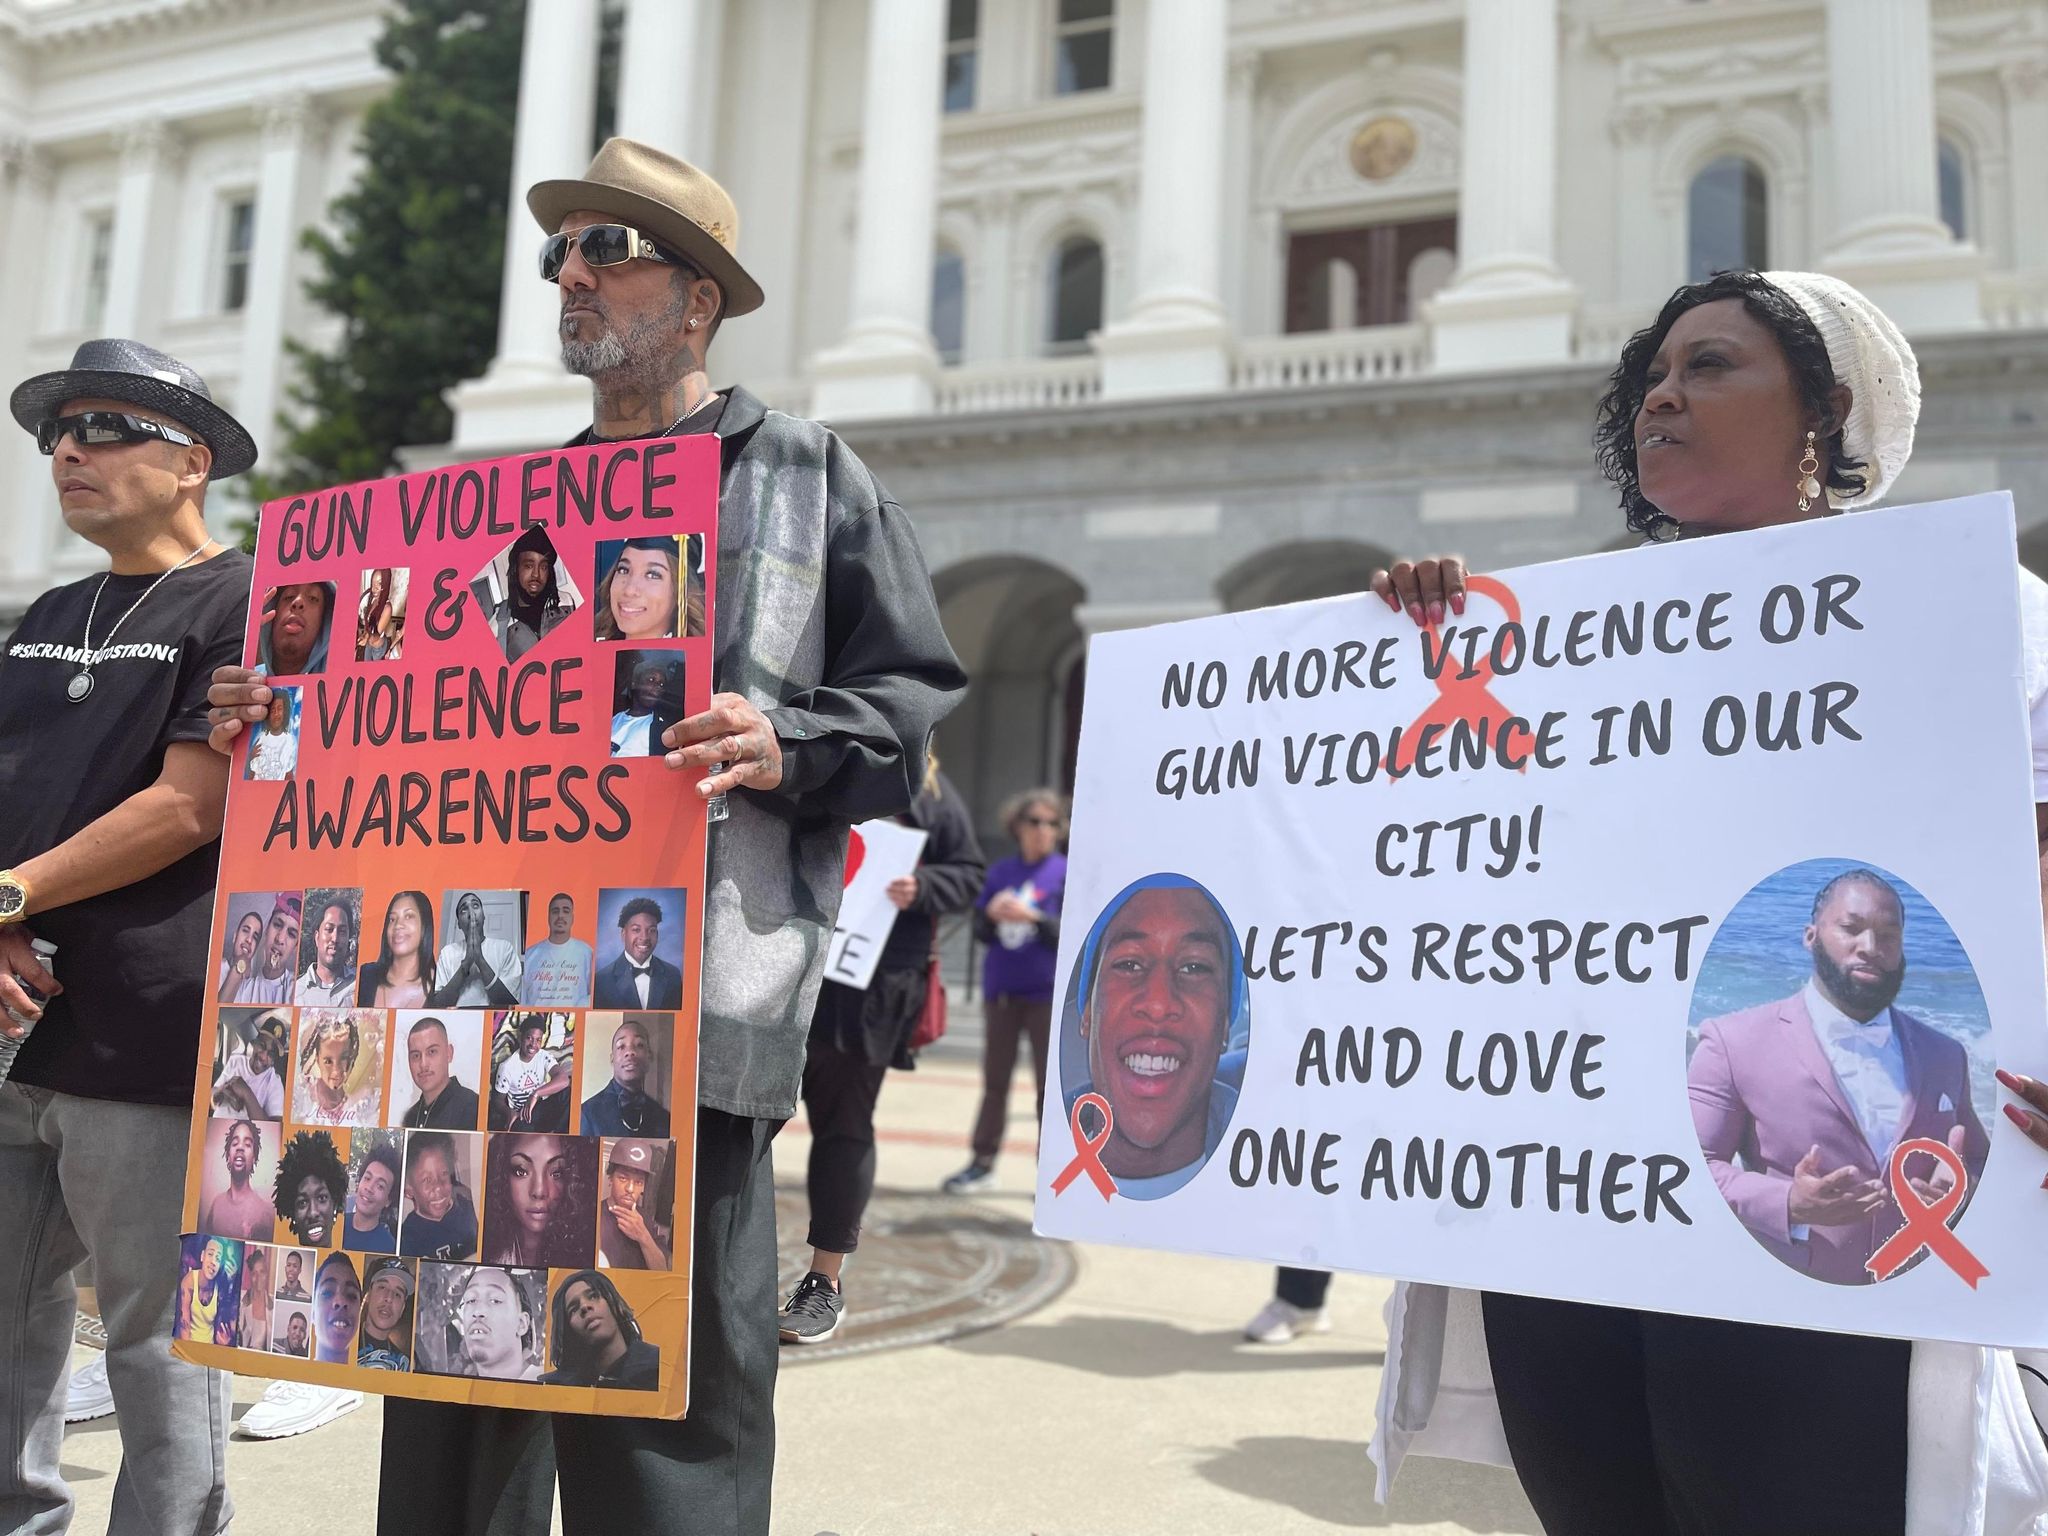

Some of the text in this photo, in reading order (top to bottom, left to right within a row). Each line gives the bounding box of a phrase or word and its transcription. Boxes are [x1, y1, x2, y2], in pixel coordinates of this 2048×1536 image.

[277, 443, 677, 566] GUN VIOLENCE
[424, 567, 469, 641] &
[1162, 573, 1864, 711] NO MORE VIOLENCE OR
[317, 656, 584, 750] VIOLENCE
[1156, 681, 1863, 802] GUN VIOLENCE IN OUR
[262, 763, 632, 852] AWARENESS
[1374, 804, 1545, 879] CITY!
[1242, 914, 1710, 986] LET'S RESPECT
[1294, 1024, 1607, 1101] AND LOVE
[1228, 1126, 1694, 1227] ONE ANOTHER
